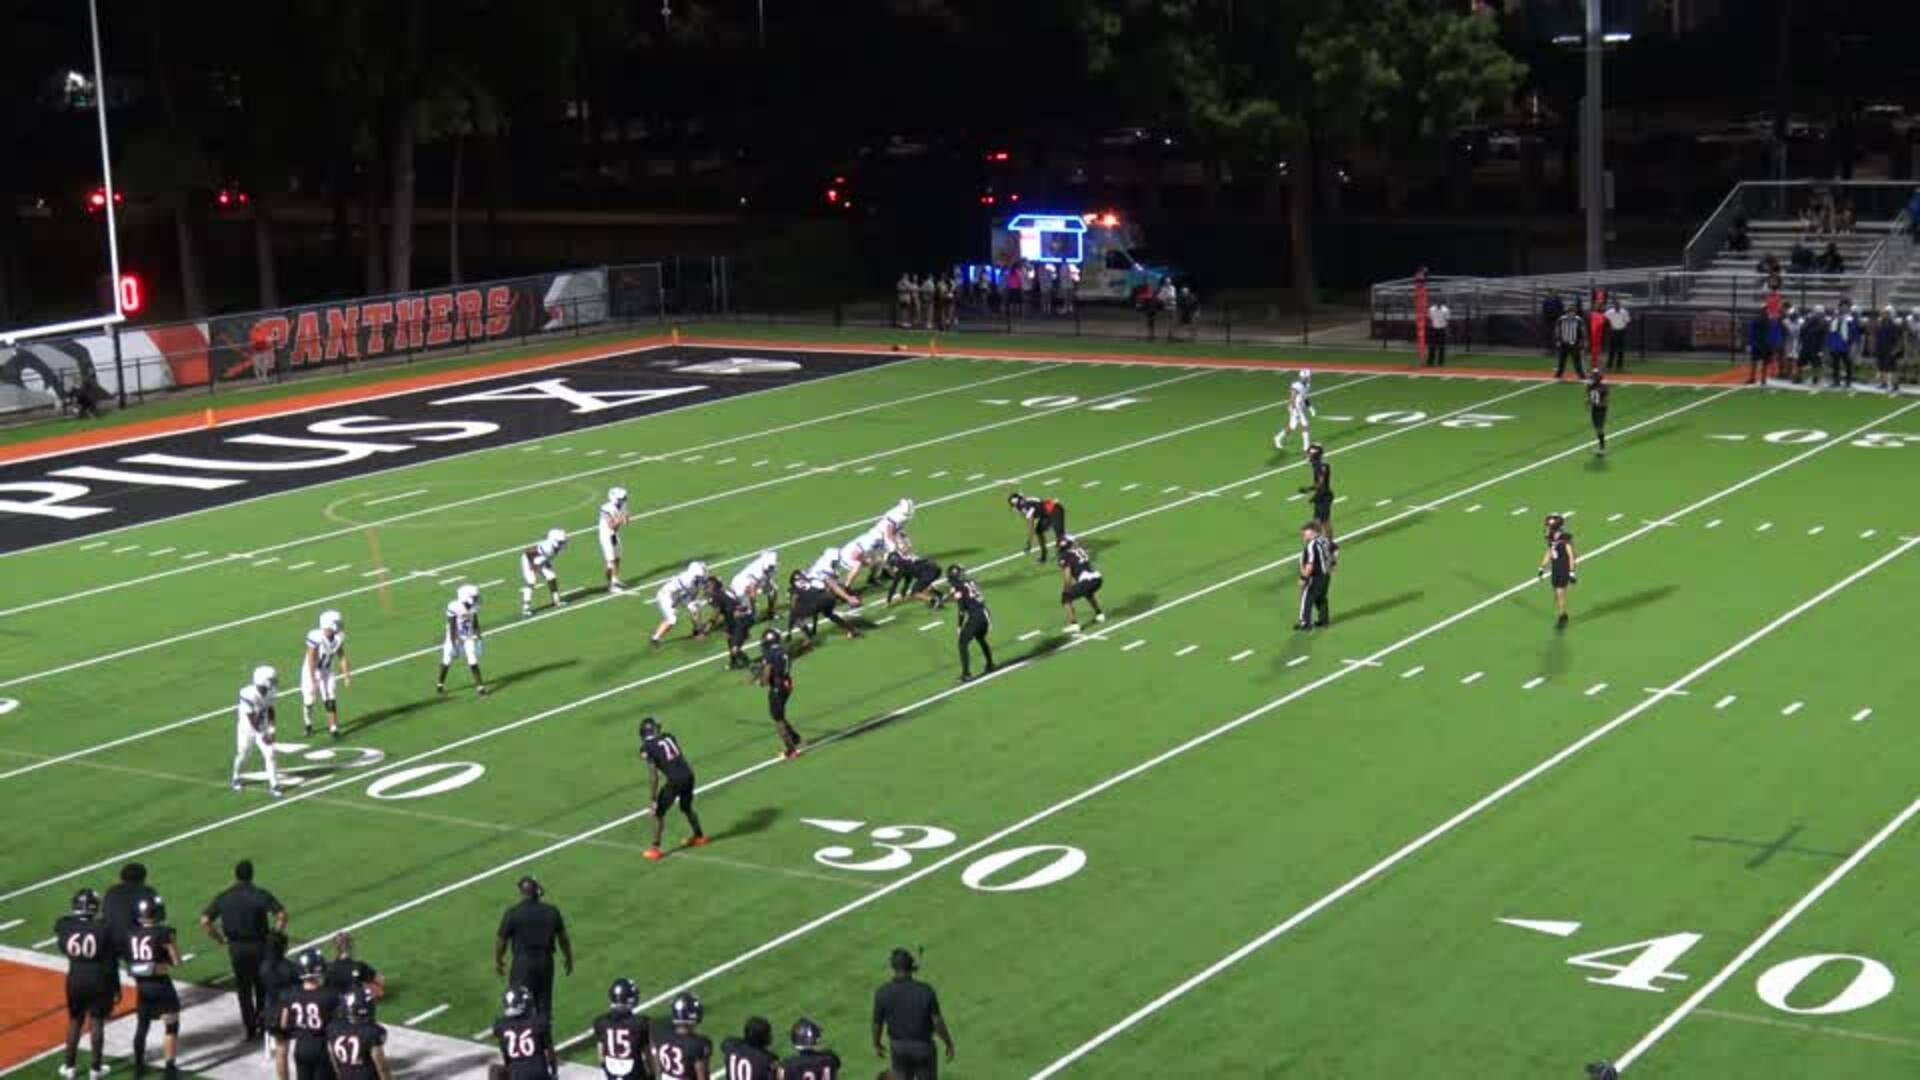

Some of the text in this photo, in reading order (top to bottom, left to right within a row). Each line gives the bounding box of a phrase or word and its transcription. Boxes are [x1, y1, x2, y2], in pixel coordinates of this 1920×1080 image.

[120, 277, 140, 312] 0
[251, 285, 513, 365] PANTHERS
[0, 415, 501, 520] PIUS
[813, 825, 1087, 891] 30
[66, 933, 97, 958] 60
[131, 935, 153, 960] 16
[1567, 932, 1895, 1014] 40
[291, 1002, 322, 1029] 28
[334, 1035, 363, 1065] 62
[503, 1029, 535, 1057] 26
[606, 1028, 631, 1057] 15
[658, 1043, 683, 1075] 63
